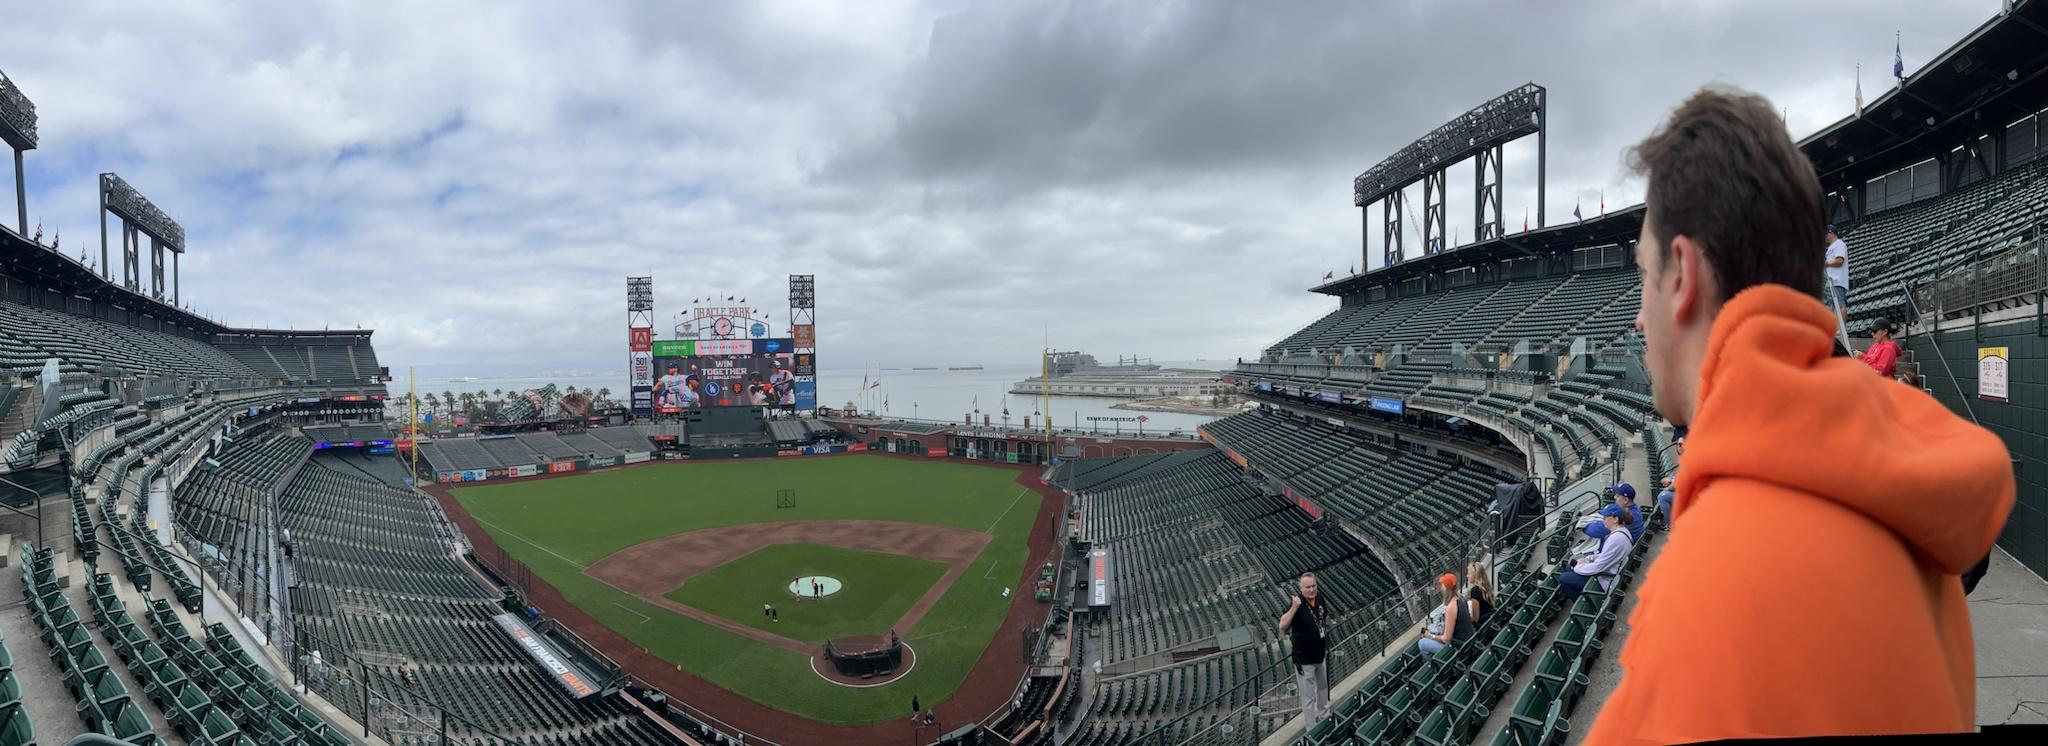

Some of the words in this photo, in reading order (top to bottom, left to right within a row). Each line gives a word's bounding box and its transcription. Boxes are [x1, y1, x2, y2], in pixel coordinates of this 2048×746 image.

[694, 307, 727, 319] ORACLE
[729, 307, 751, 319] PARK
[635, 357, 647, 366] 501
[715, 360, 733, 368] WIN
[701, 368, 748, 376] TOGETHER
[976, 431, 1006, 440] LANDING
[560, 672, 592, 695] GIANTS
